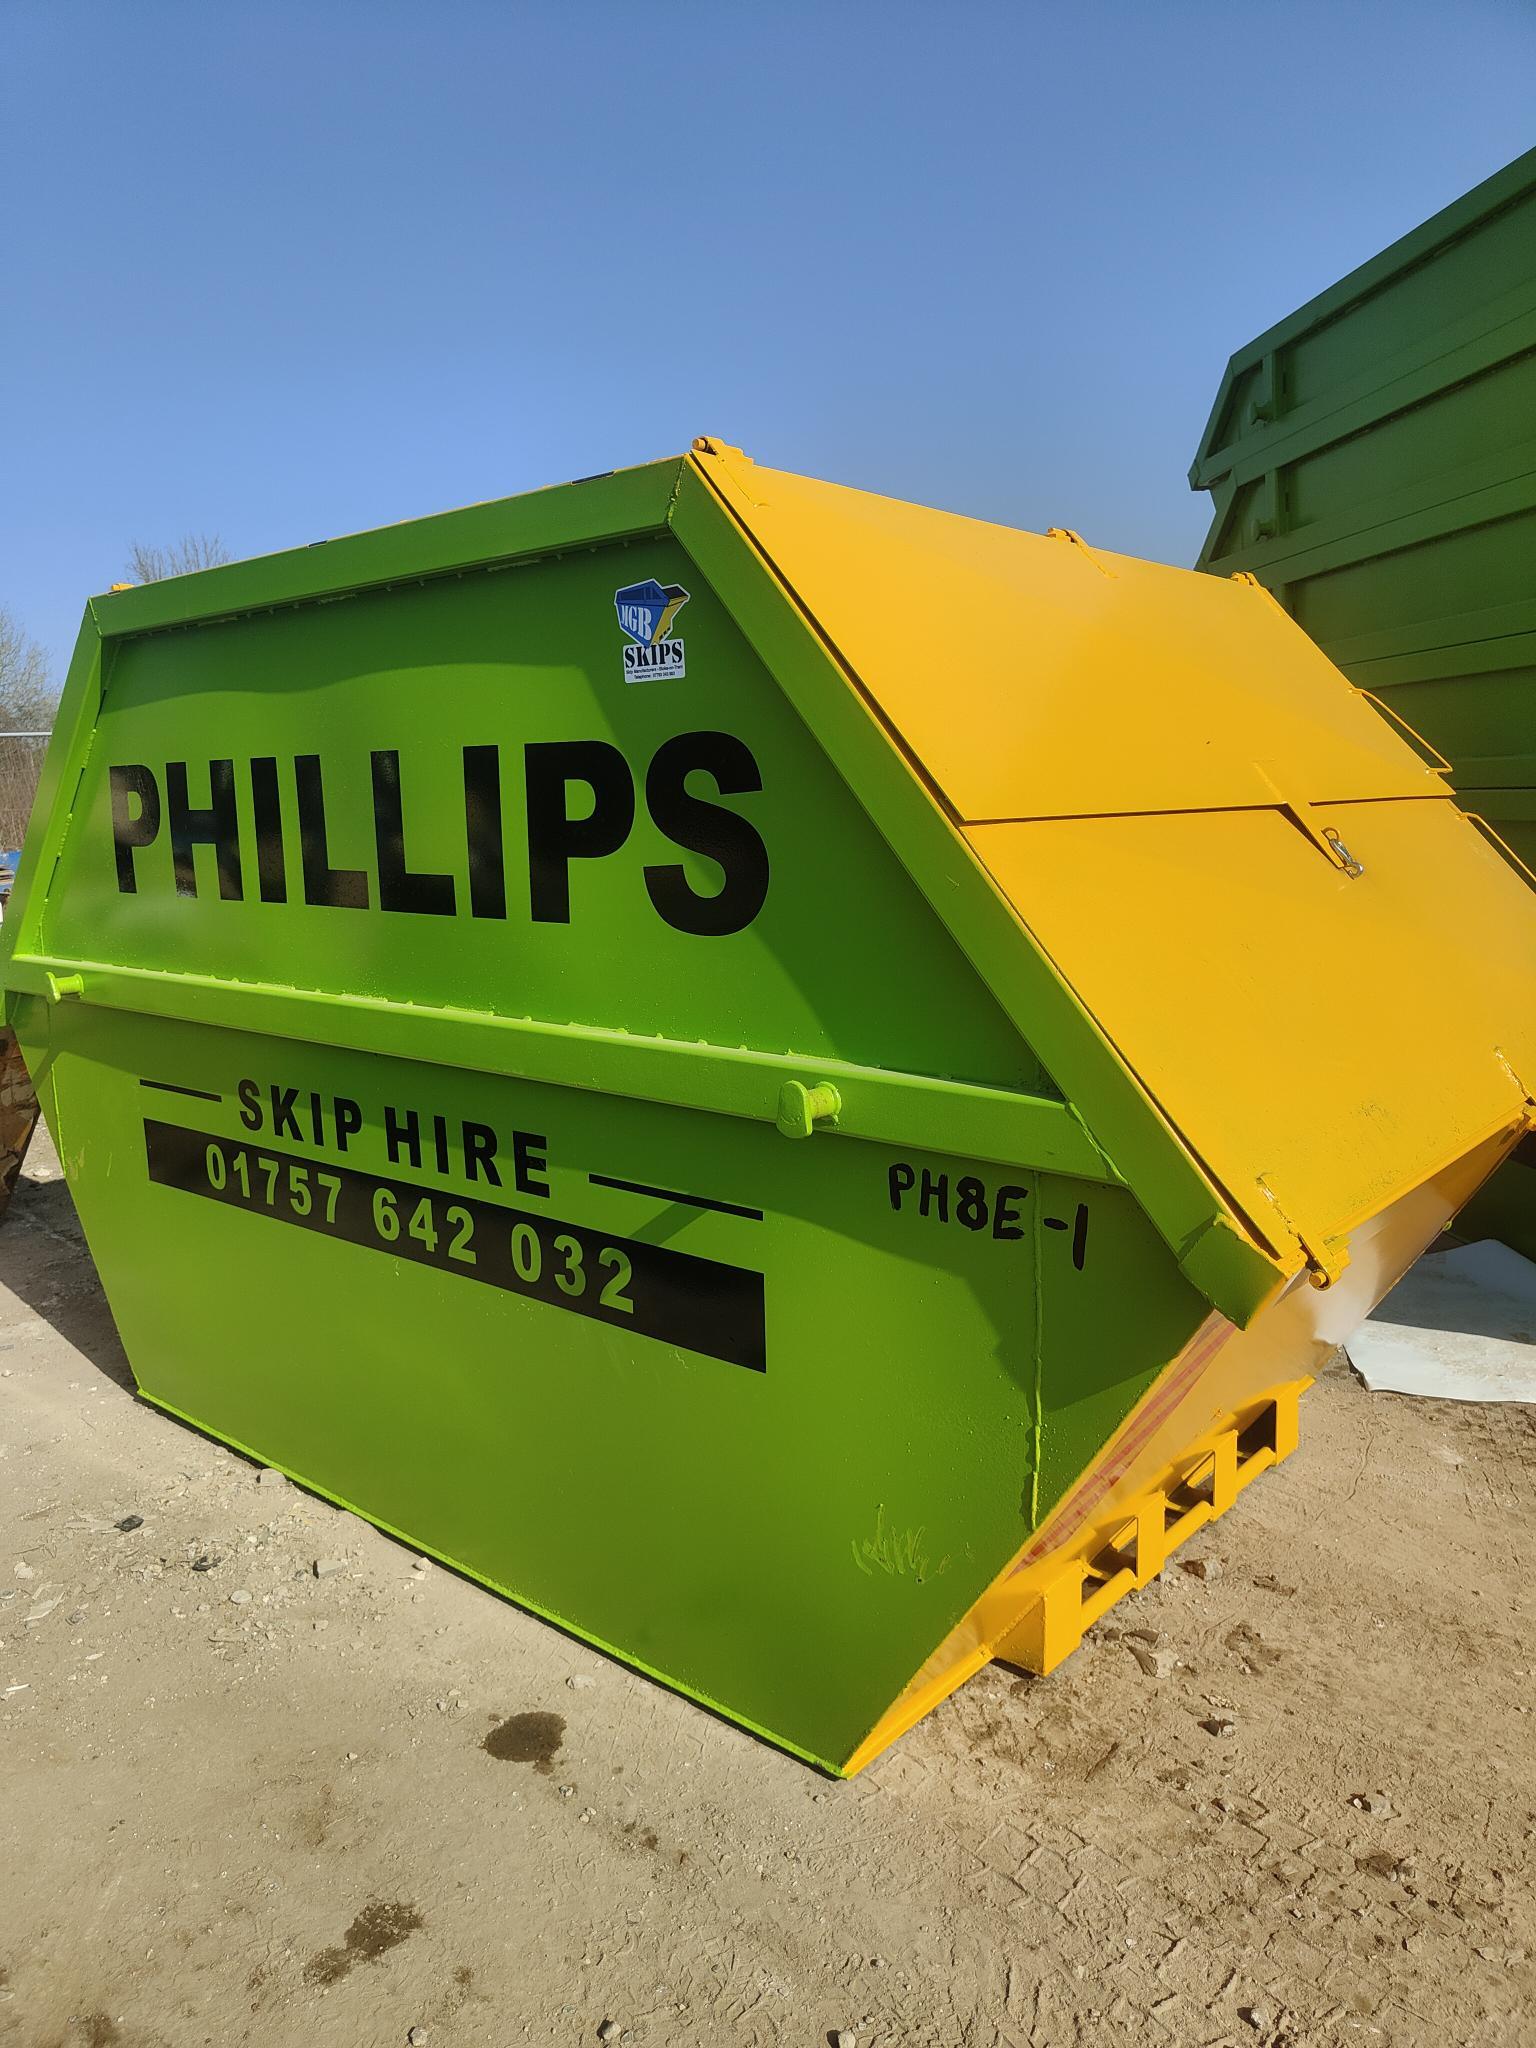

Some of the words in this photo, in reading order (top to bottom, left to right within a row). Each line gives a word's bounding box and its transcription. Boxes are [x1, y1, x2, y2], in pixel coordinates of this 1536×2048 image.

[625, 641, 682, 668] SKIPS
[109, 730, 770, 937] PHILLIPS
[237, 1079, 363, 1152] SKIP
[383, 1106, 551, 1199] HIRE
[205, 1143, 343, 1224] 01757
[371, 1187, 478, 1265] 642
[510, 1223, 635, 1314] 032
